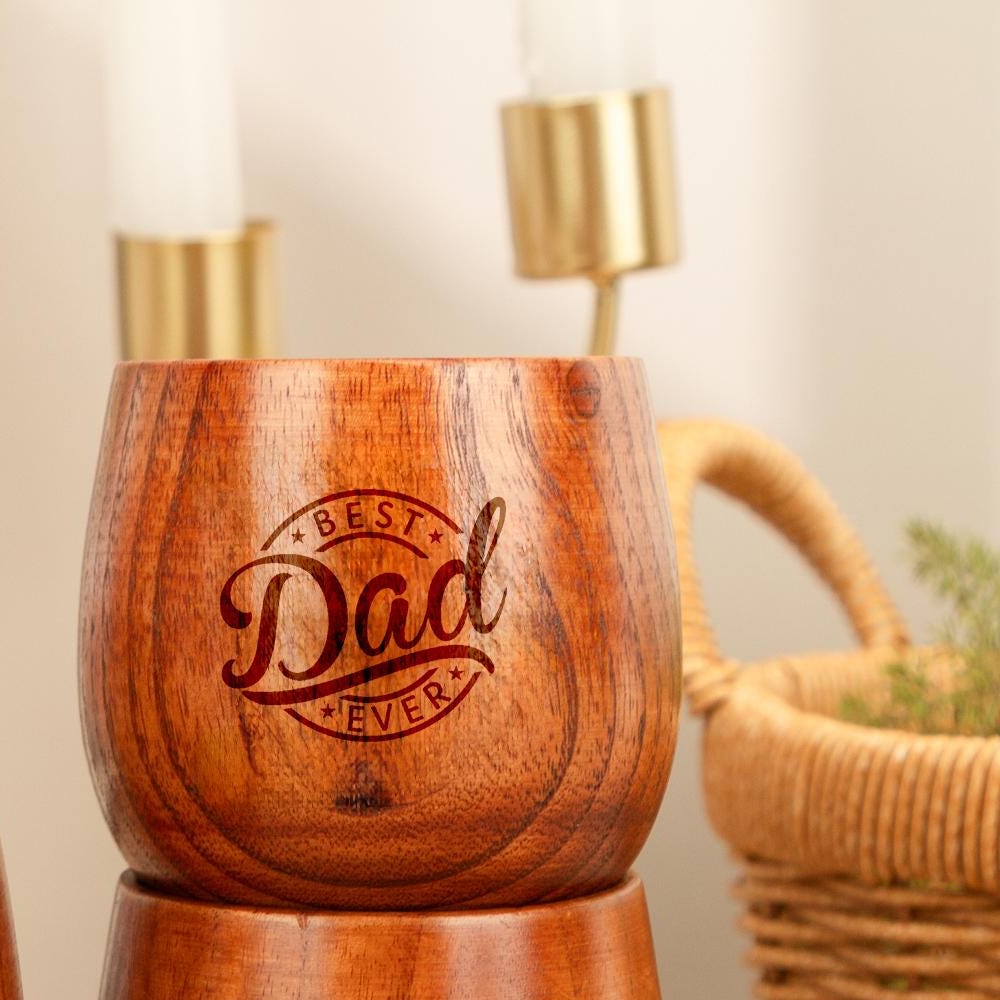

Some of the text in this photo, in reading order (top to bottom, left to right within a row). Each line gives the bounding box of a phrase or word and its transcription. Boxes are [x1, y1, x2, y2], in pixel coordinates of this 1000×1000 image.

[312, 501, 424, 537] BEST
[219, 496, 507, 689] Dad
[347, 681, 451, 733] EVER
